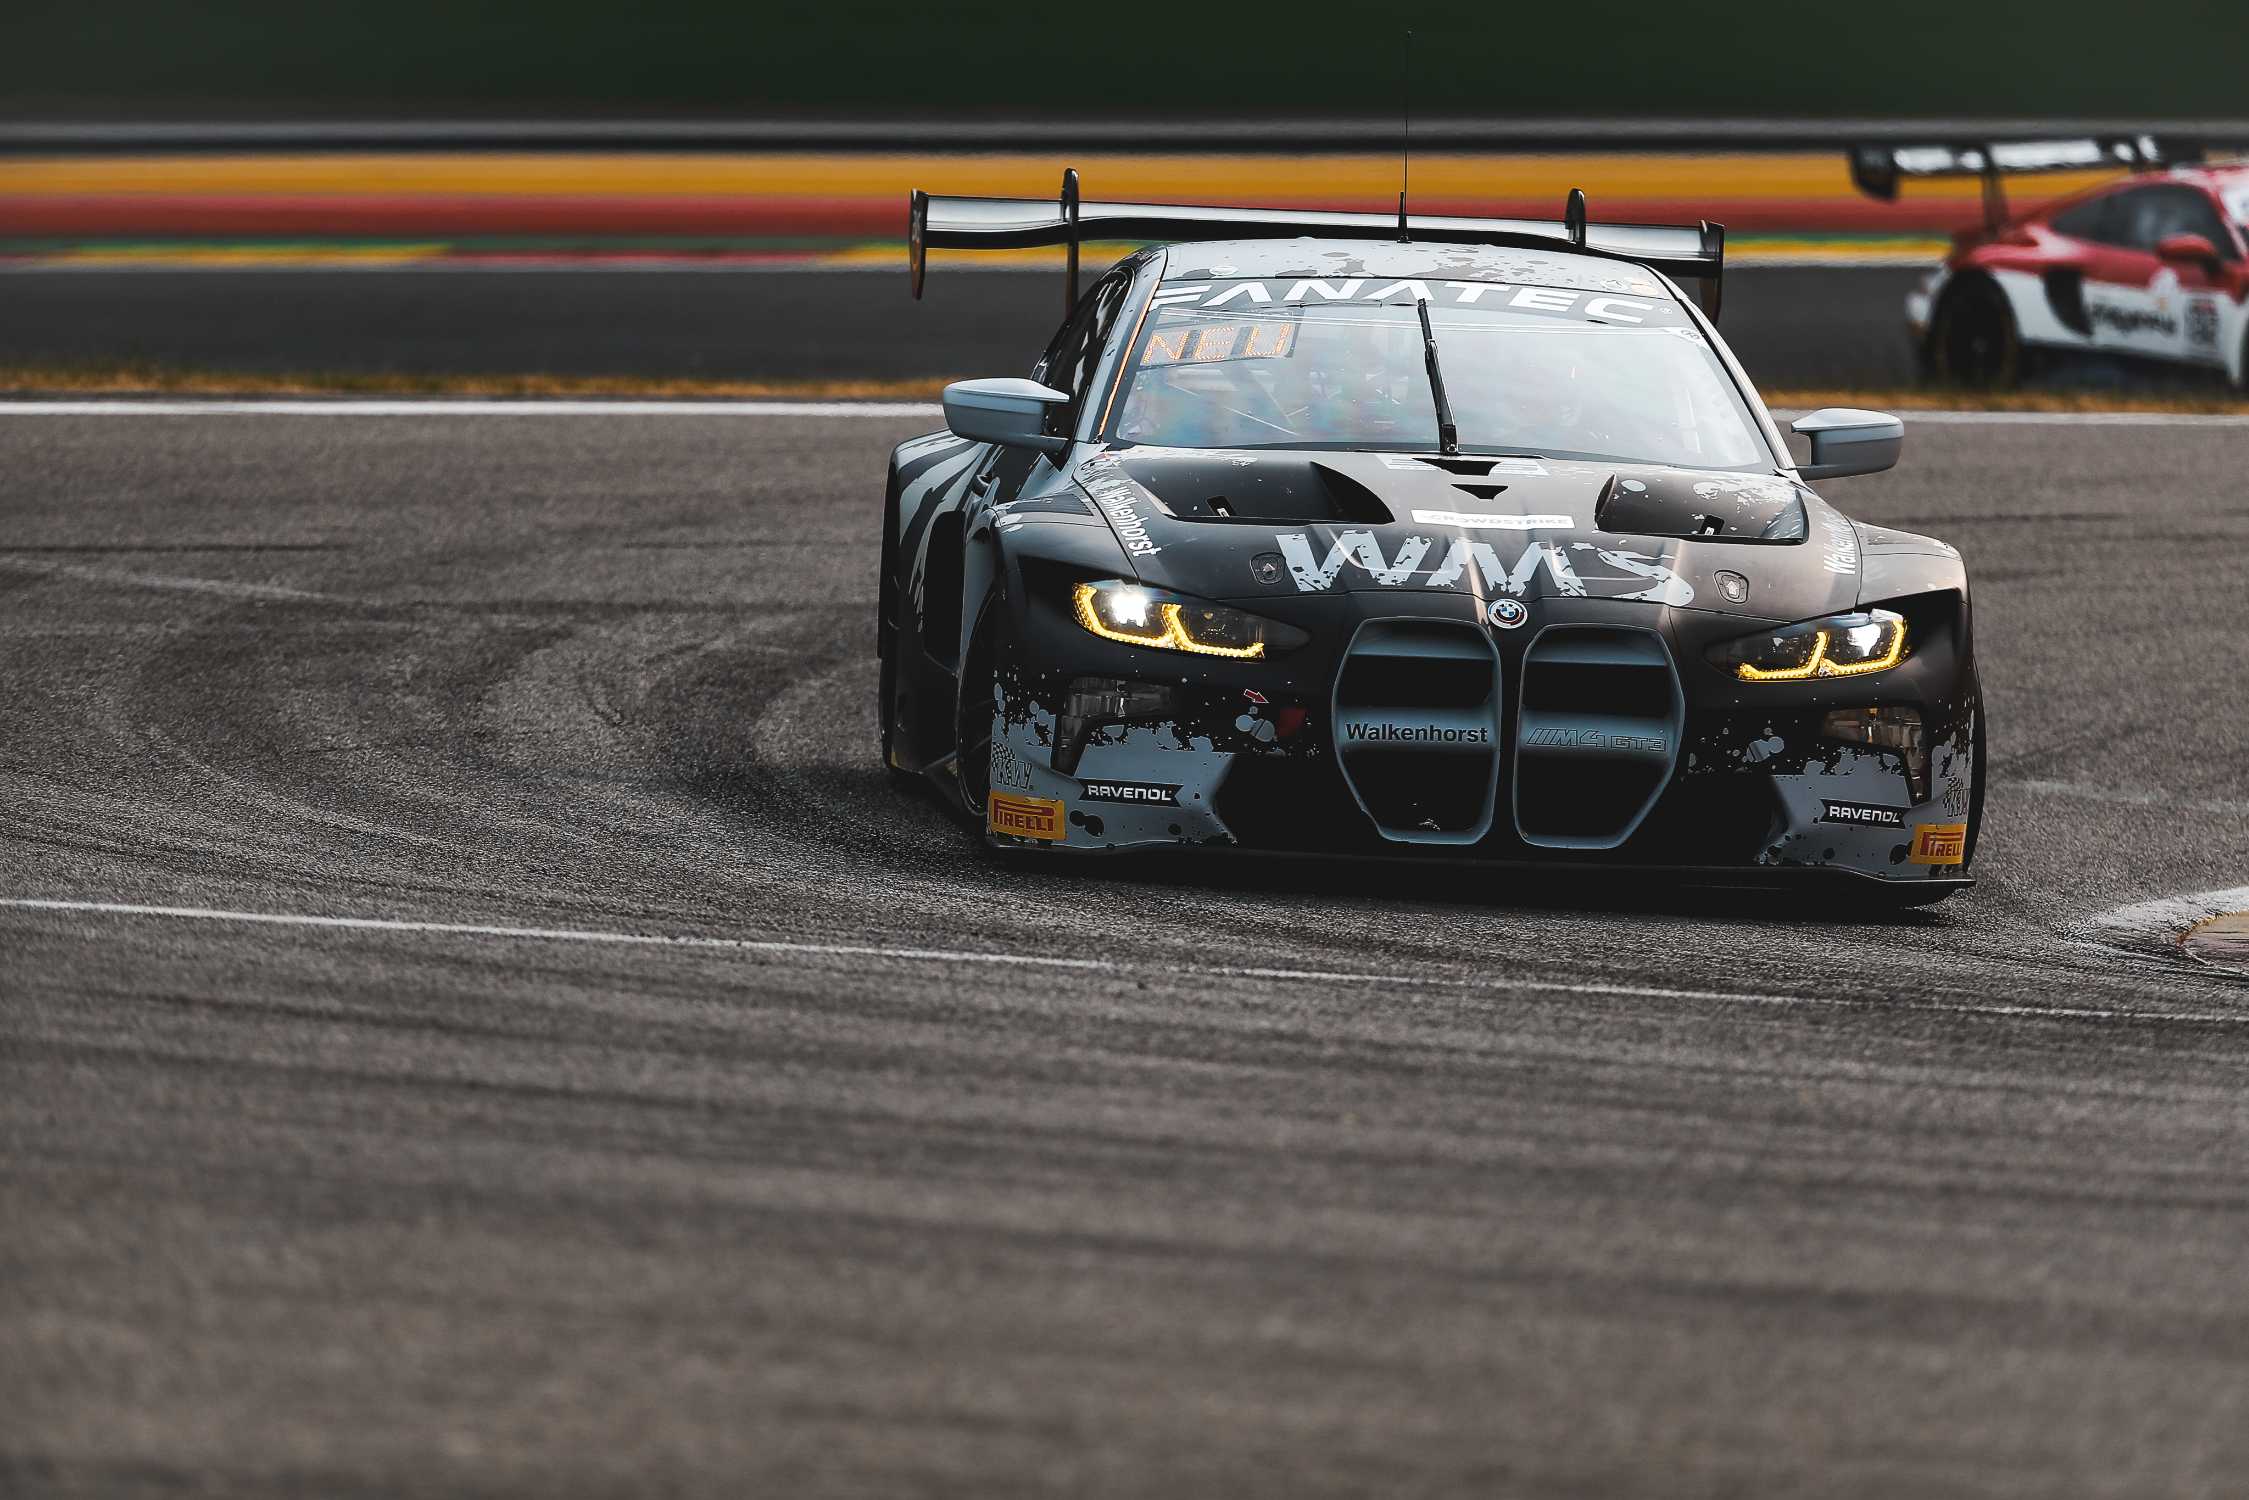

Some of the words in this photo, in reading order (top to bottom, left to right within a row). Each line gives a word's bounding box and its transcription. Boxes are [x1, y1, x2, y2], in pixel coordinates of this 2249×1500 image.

[1149, 278, 1654, 324] FANATEC
[1143, 323, 1292, 364] NEU
[1098, 485, 1162, 557] Walkenhorst
[1275, 530, 1695, 606] WMS
[1345, 722, 1488, 743] Walkenhorst
[1610, 735, 1667, 751] GT3
[1087, 784, 1173, 801] RAVENOL
[994, 798, 1055, 833] PIRELLI
[1829, 805, 1901, 823] RAVENOL
